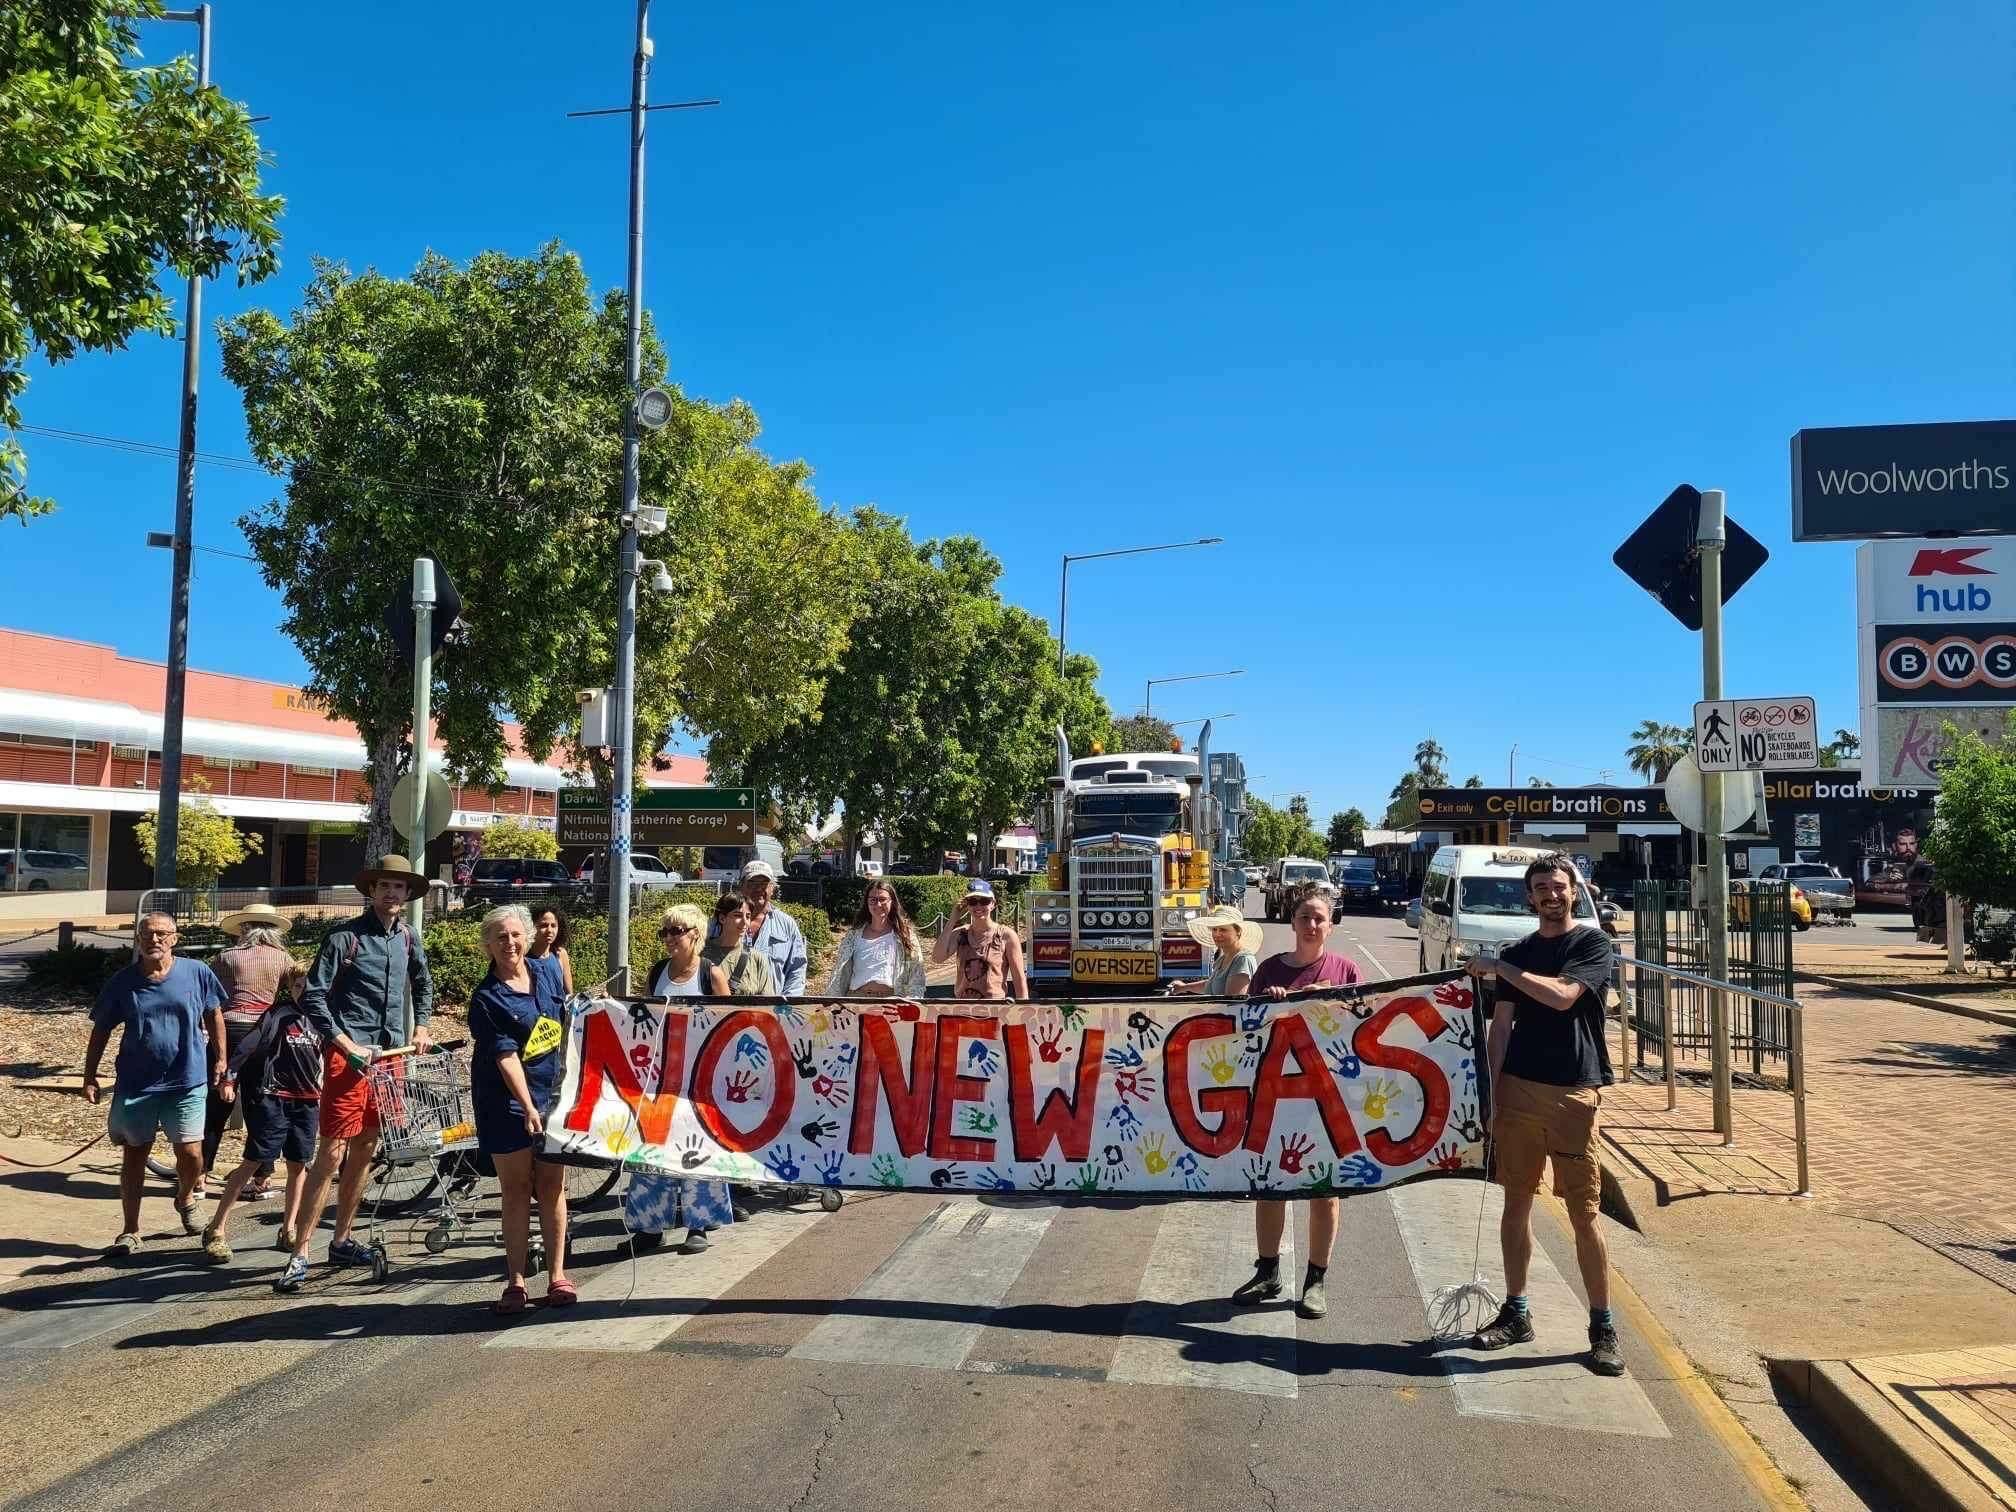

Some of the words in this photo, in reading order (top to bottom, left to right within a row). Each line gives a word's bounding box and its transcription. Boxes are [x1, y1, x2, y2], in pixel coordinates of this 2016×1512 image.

[1817, 459, 2010, 496] Woolworths
[1908, 548, 2000, 576] K
[1916, 583, 1992, 612] hub
[1901, 652, 2012, 673] BWS
[1768, 732, 1796, 741] BICYCLES
[1768, 741, 1811, 751] SKATEBOARDS
[1702, 748, 1732, 763] ONLY
[1740, 733, 1766, 762] NO
[1768, 751, 1815, 761] ROLLERBLADES
[563, 794, 602, 804] Darwi
[1764, 780, 1919, 800] ellarbrations
[1437, 802, 1454, 813] Exit
[1456, 802, 1473, 815] only
[1486, 795, 1647, 816] Cellarbrations
[563, 814, 609, 825] Nitmilu
[631, 814, 682, 825] atherine
[688, 814, 728, 828] Gorge)
[563, 831, 609, 841] Nationa
[632, 831, 645, 841] rk
[1074, 957, 1155, 976] OVERSIZE
[564, 1010, 796, 1153] NO
[847, 1013, 1106, 1163] NEW
[1163, 996, 1451, 1167] GAS
